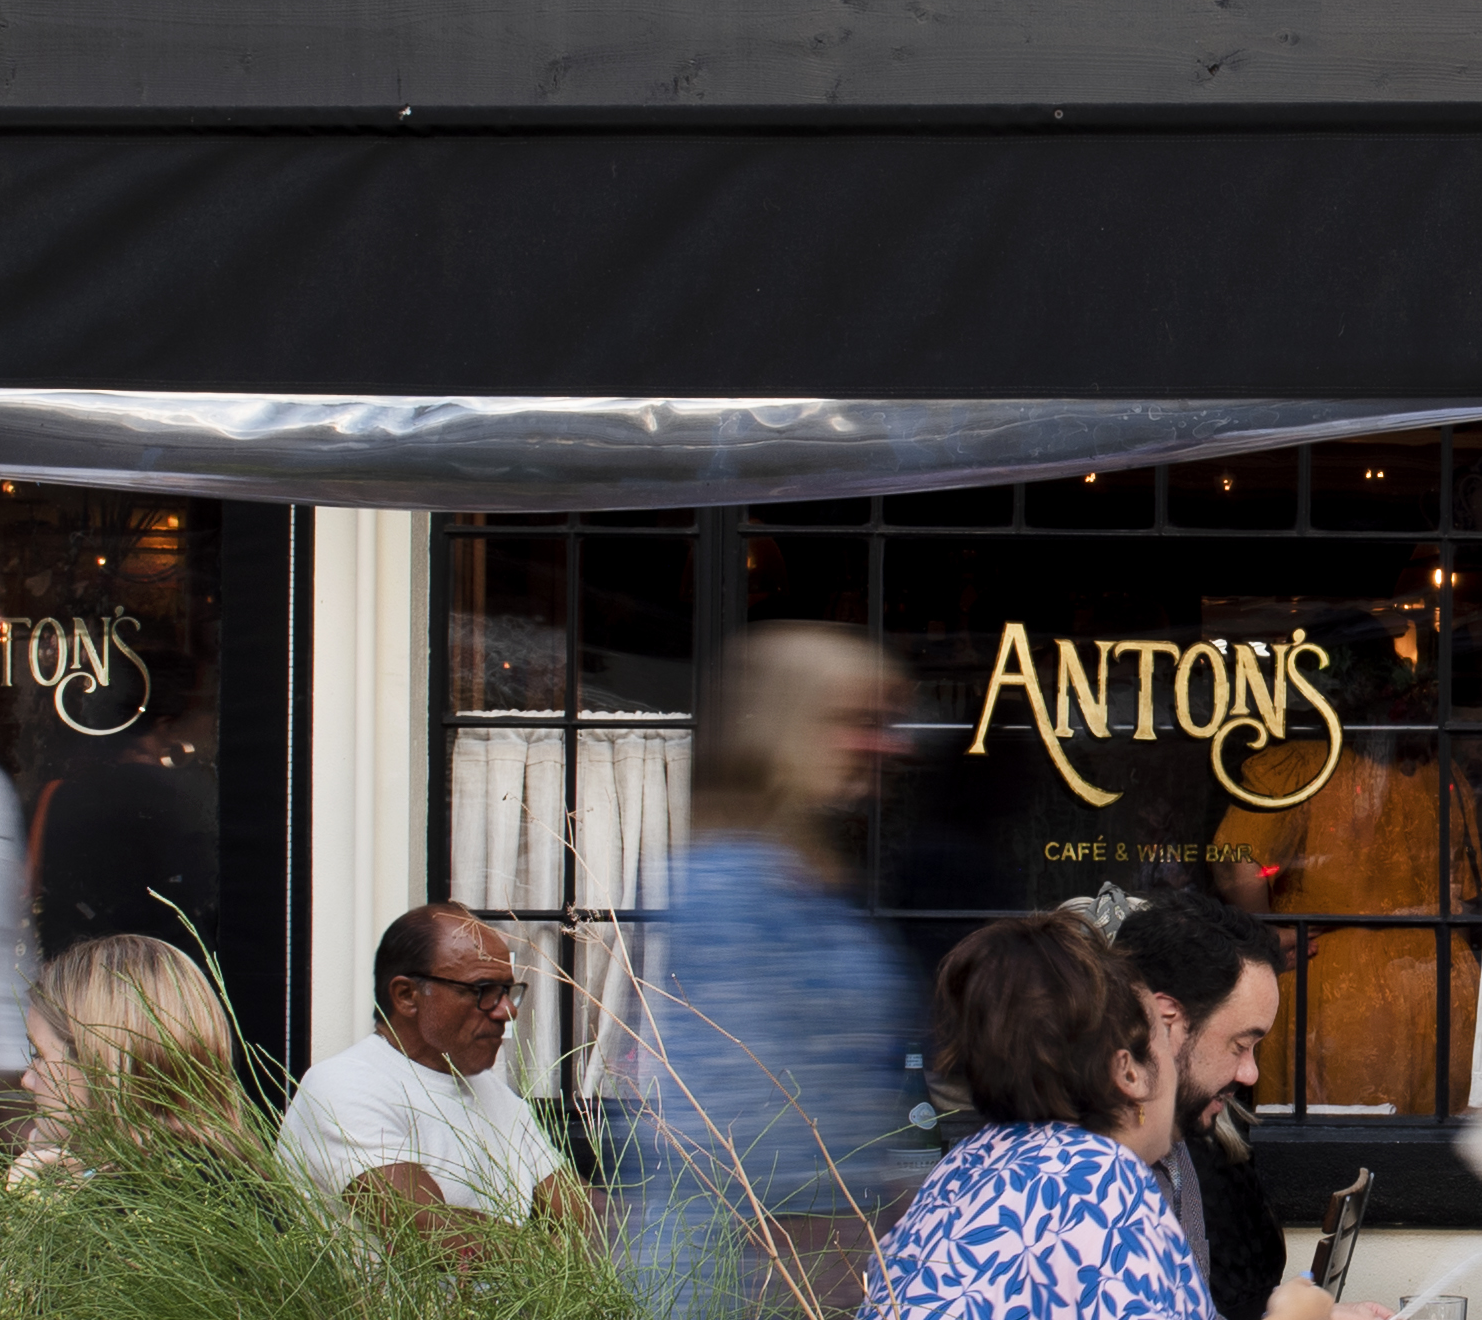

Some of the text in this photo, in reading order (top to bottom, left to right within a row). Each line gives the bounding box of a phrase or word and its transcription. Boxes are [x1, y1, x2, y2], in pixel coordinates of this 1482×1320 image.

[964, 621, 1343, 811] ANTON'S
[1044, 835, 1253, 863] CAFÉ & WINE BAR
